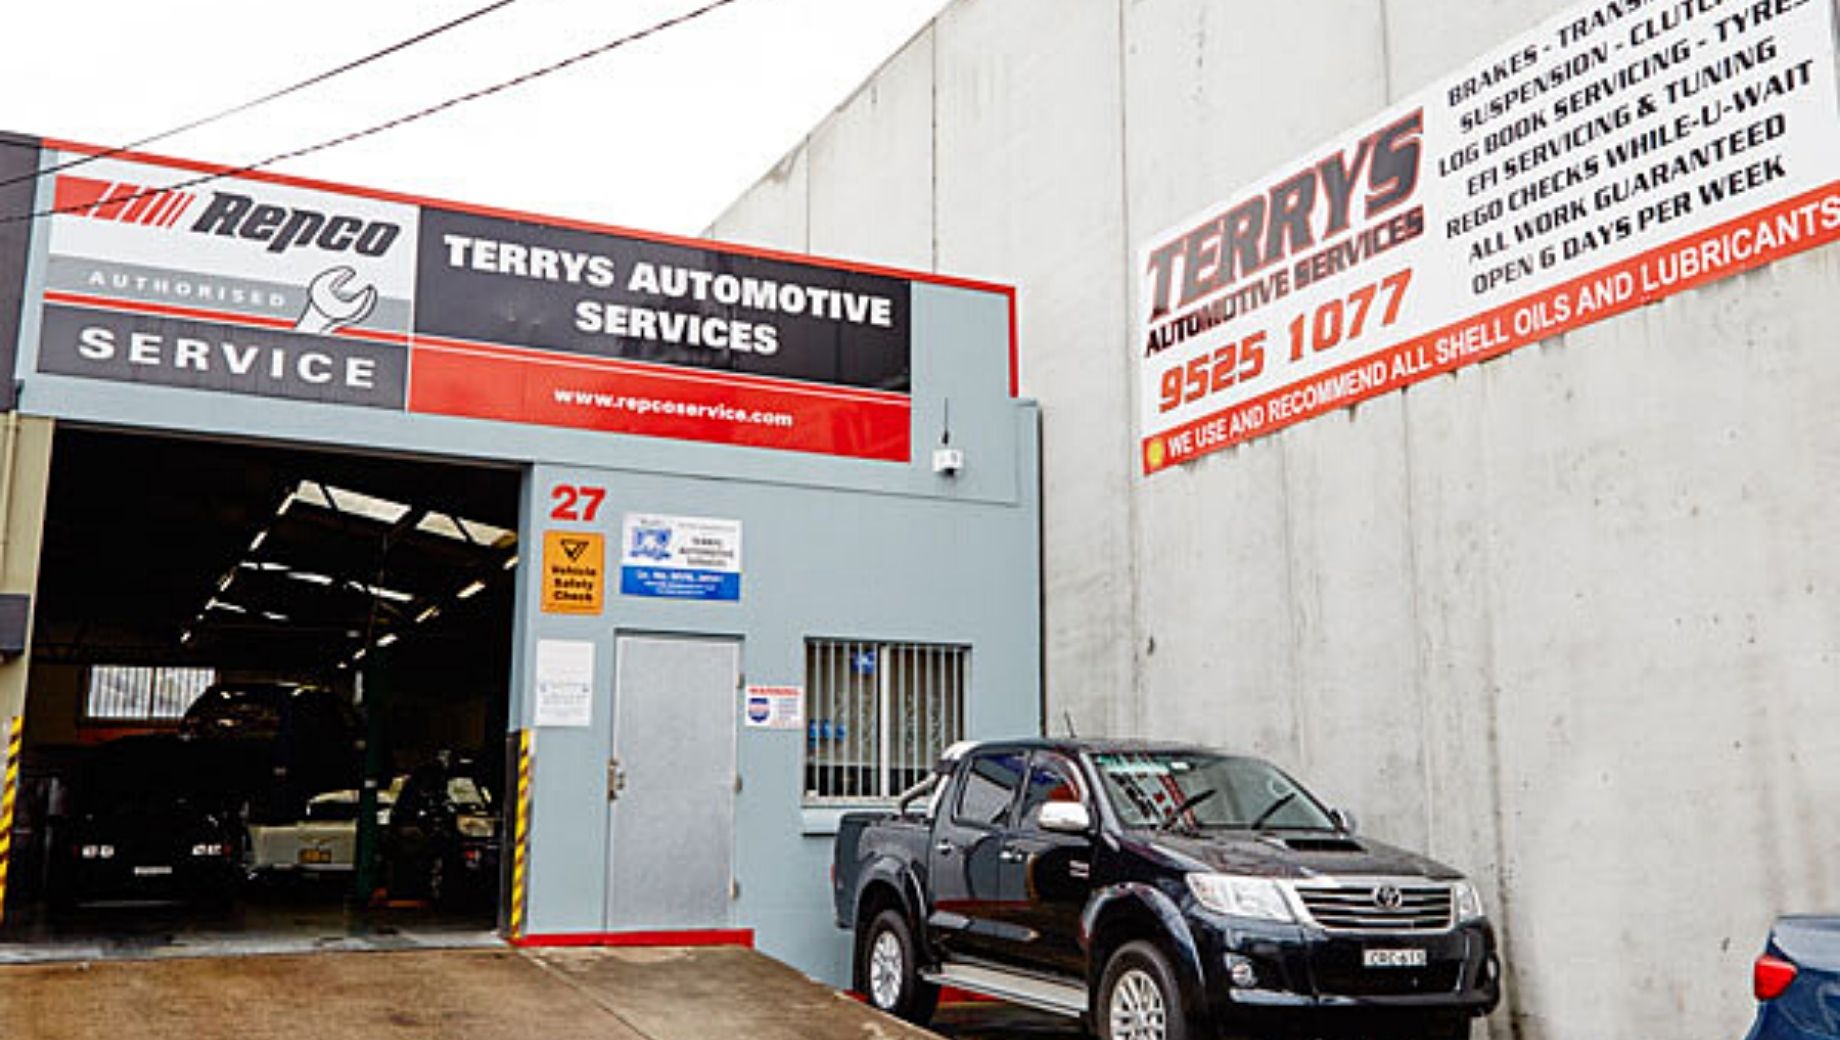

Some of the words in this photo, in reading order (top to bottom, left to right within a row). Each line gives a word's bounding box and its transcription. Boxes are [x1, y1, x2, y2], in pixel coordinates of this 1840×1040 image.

[1438, 142, 1480, 178] LOG
[1484, 108, 1548, 156] BOOK
[1554, 38, 1691, 122] SERVICING
[1448, 44, 1538, 108] BRAKES
[1460, 42, 1609, 134] SUSPENSION
[1468, 166, 1498, 197] EFI
[1504, 103, 1631, 180] SERVICING
[1636, 93, 1657, 119] &
[1664, 36, 1777, 104] TUNING
[1446, 198, 1504, 239] REGO
[1508, 154, 1600, 211] CHECKS
[1605, 59, 1814, 169] WHILE-U-WAIT
[1469, 231, 1511, 264] ALL
[1514, 197, 1587, 243] WORK
[1594, 112, 1786, 211] GUARANTEED
[191, 191, 401, 259] Repco
[1146, 106, 1425, 324] TERRYS
[1472, 254, 1534, 295] OPEN
[1563, 215, 1631, 260] DAYS
[1638, 192, 1692, 231] PER
[1698, 154, 1786, 206] WEEK
[88, 270, 287, 308] AUTHORISED
[444, 234, 615, 287] TERRYS
[628, 261, 894, 328] AUTOMOTIVE
[576, 301, 779, 356] SERVICES
[1145, 267, 1290, 358] AUTOMOTIVE
[1293, 204, 1425, 291] SERVICES
[1167, 430, 1195, 458] WE
[1195, 417, 1228, 450] USE
[1229, 403, 1265, 441] AND
[1268, 358, 1388, 424] RECOMMEND
[1391, 345, 1433, 381] ALL
[1435, 316, 1510, 365] SHELL
[1514, 294, 1572, 336] OILS
[1575, 271, 1634, 316] AND
[1640, 195, 1840, 293] LUBRICANTS
[78, 327, 376, 389] SERVICE
[1158, 329, 1267, 414] 9525
[1288, 267, 1413, 362] 1077
[553, 387, 794, 426] www.repcoservice.com
[550, 484, 606, 521] 27
